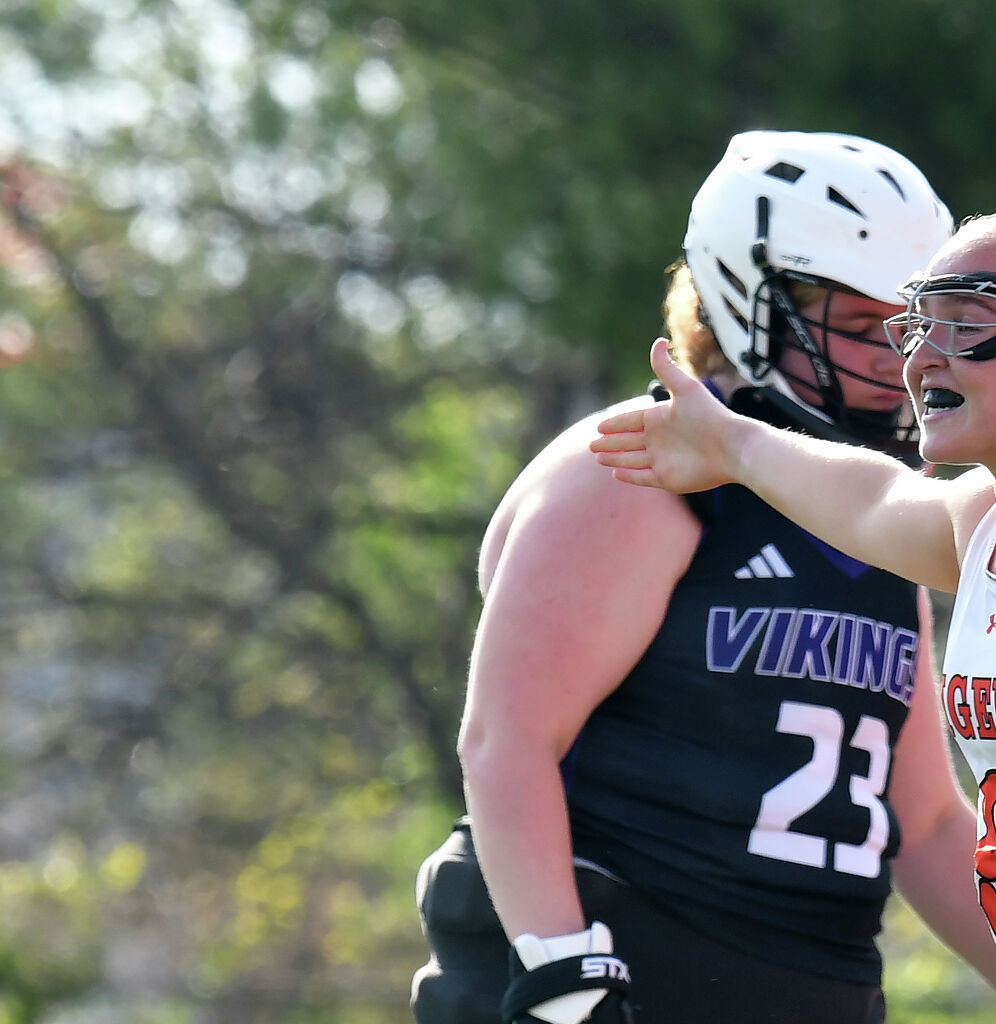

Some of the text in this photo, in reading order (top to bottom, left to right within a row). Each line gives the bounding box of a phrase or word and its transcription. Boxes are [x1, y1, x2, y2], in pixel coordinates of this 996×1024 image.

[704, 606, 919, 708] VIKING
[747, 700, 892, 879] 23
[580, 955, 632, 984] STX
